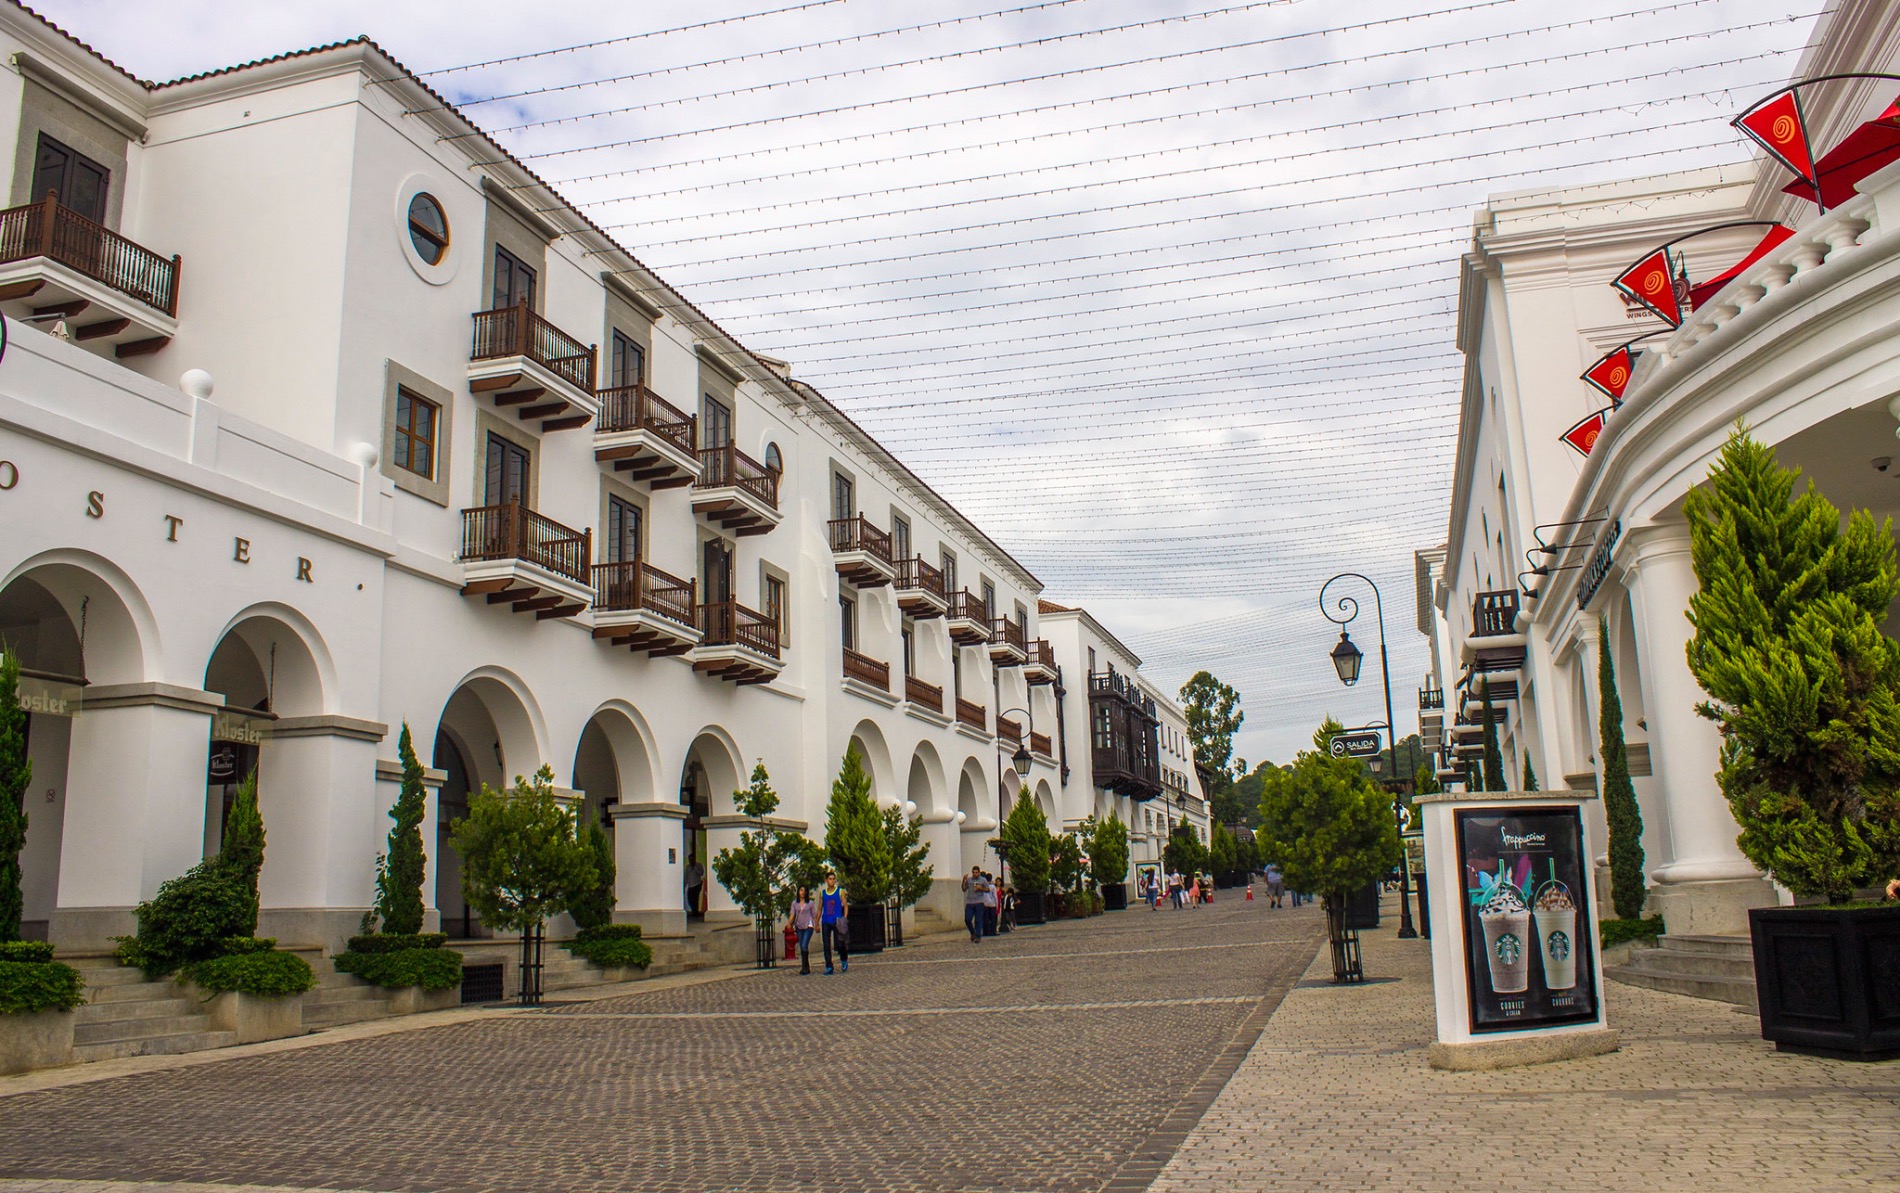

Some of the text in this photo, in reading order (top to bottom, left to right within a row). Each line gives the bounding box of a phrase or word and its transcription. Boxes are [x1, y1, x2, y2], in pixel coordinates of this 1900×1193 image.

[1626, 311, 1653, 319] WINGS
[214, 713, 262, 744] Kloster
[1346, 740, 1376, 749] SALIDA
